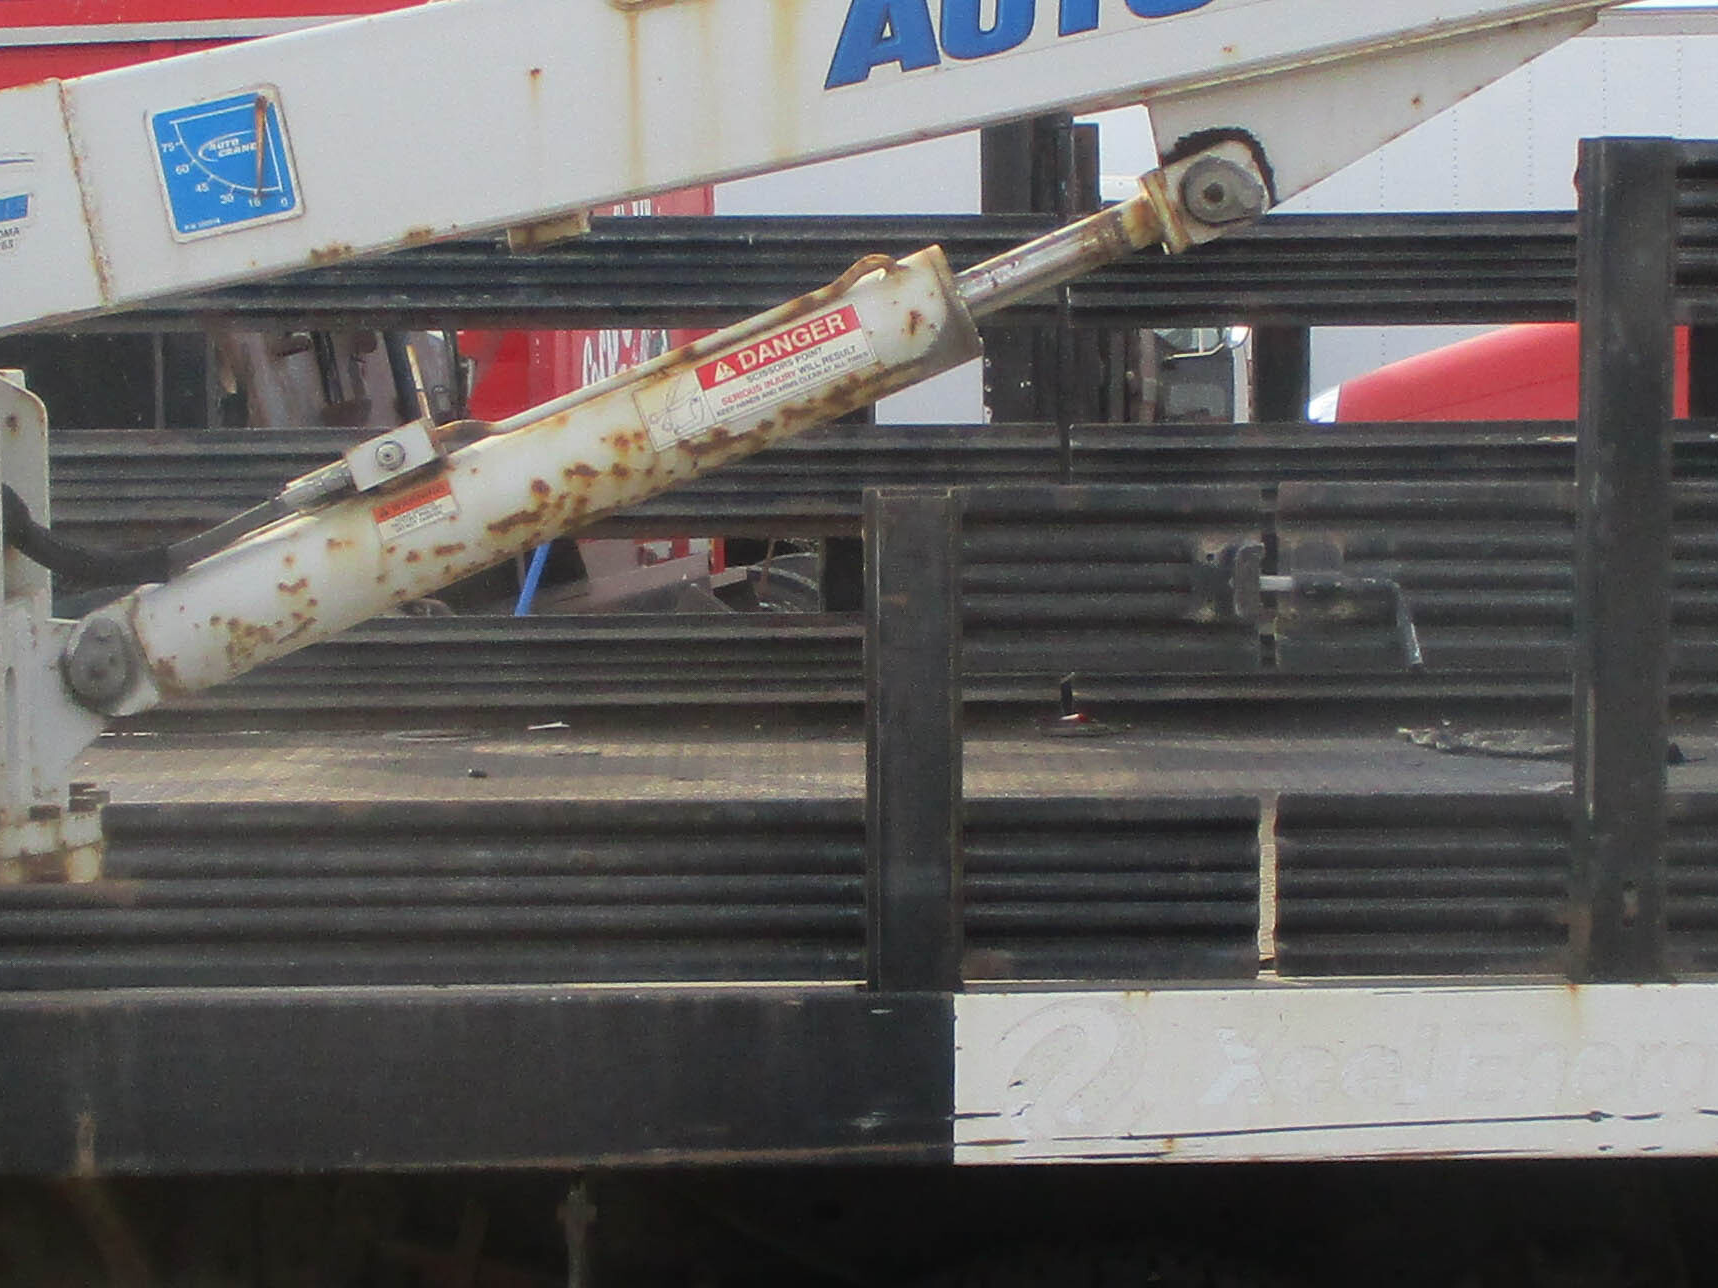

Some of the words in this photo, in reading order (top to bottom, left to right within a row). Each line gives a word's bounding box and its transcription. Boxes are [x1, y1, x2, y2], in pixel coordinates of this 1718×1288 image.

[738, 312, 847, 371] DANGER
[747, 356, 795, 383] SCISSORS
[795, 346, 823, 364] POINT
[721, 384, 764, 407] SERIOUS
[764, 370, 797, 389] INJURY
[798, 361, 821, 376] WILL
[822, 345, 857, 364] RESULT
